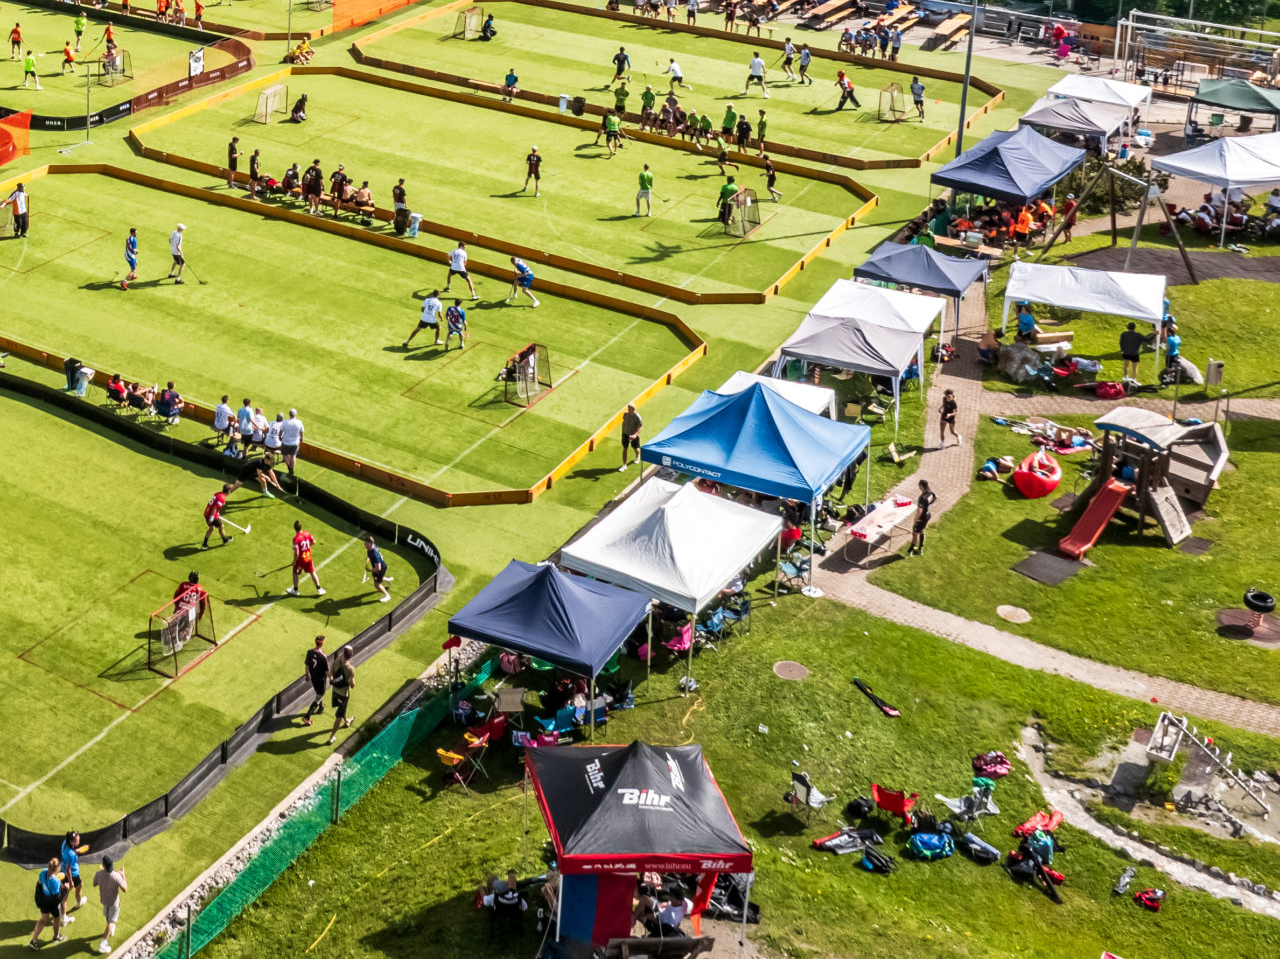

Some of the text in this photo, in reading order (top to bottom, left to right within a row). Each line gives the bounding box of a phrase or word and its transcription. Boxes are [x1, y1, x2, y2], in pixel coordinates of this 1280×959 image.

[672, 460, 722, 478] POLYCONTACT
[300, 539, 311, 551] 21
[407, 534, 439, 566] UNIH
[617, 788, 671, 807] Bihr
[644, 862, 692, 870] www.bihr.eu
[699, 859, 734, 870] Bihr
